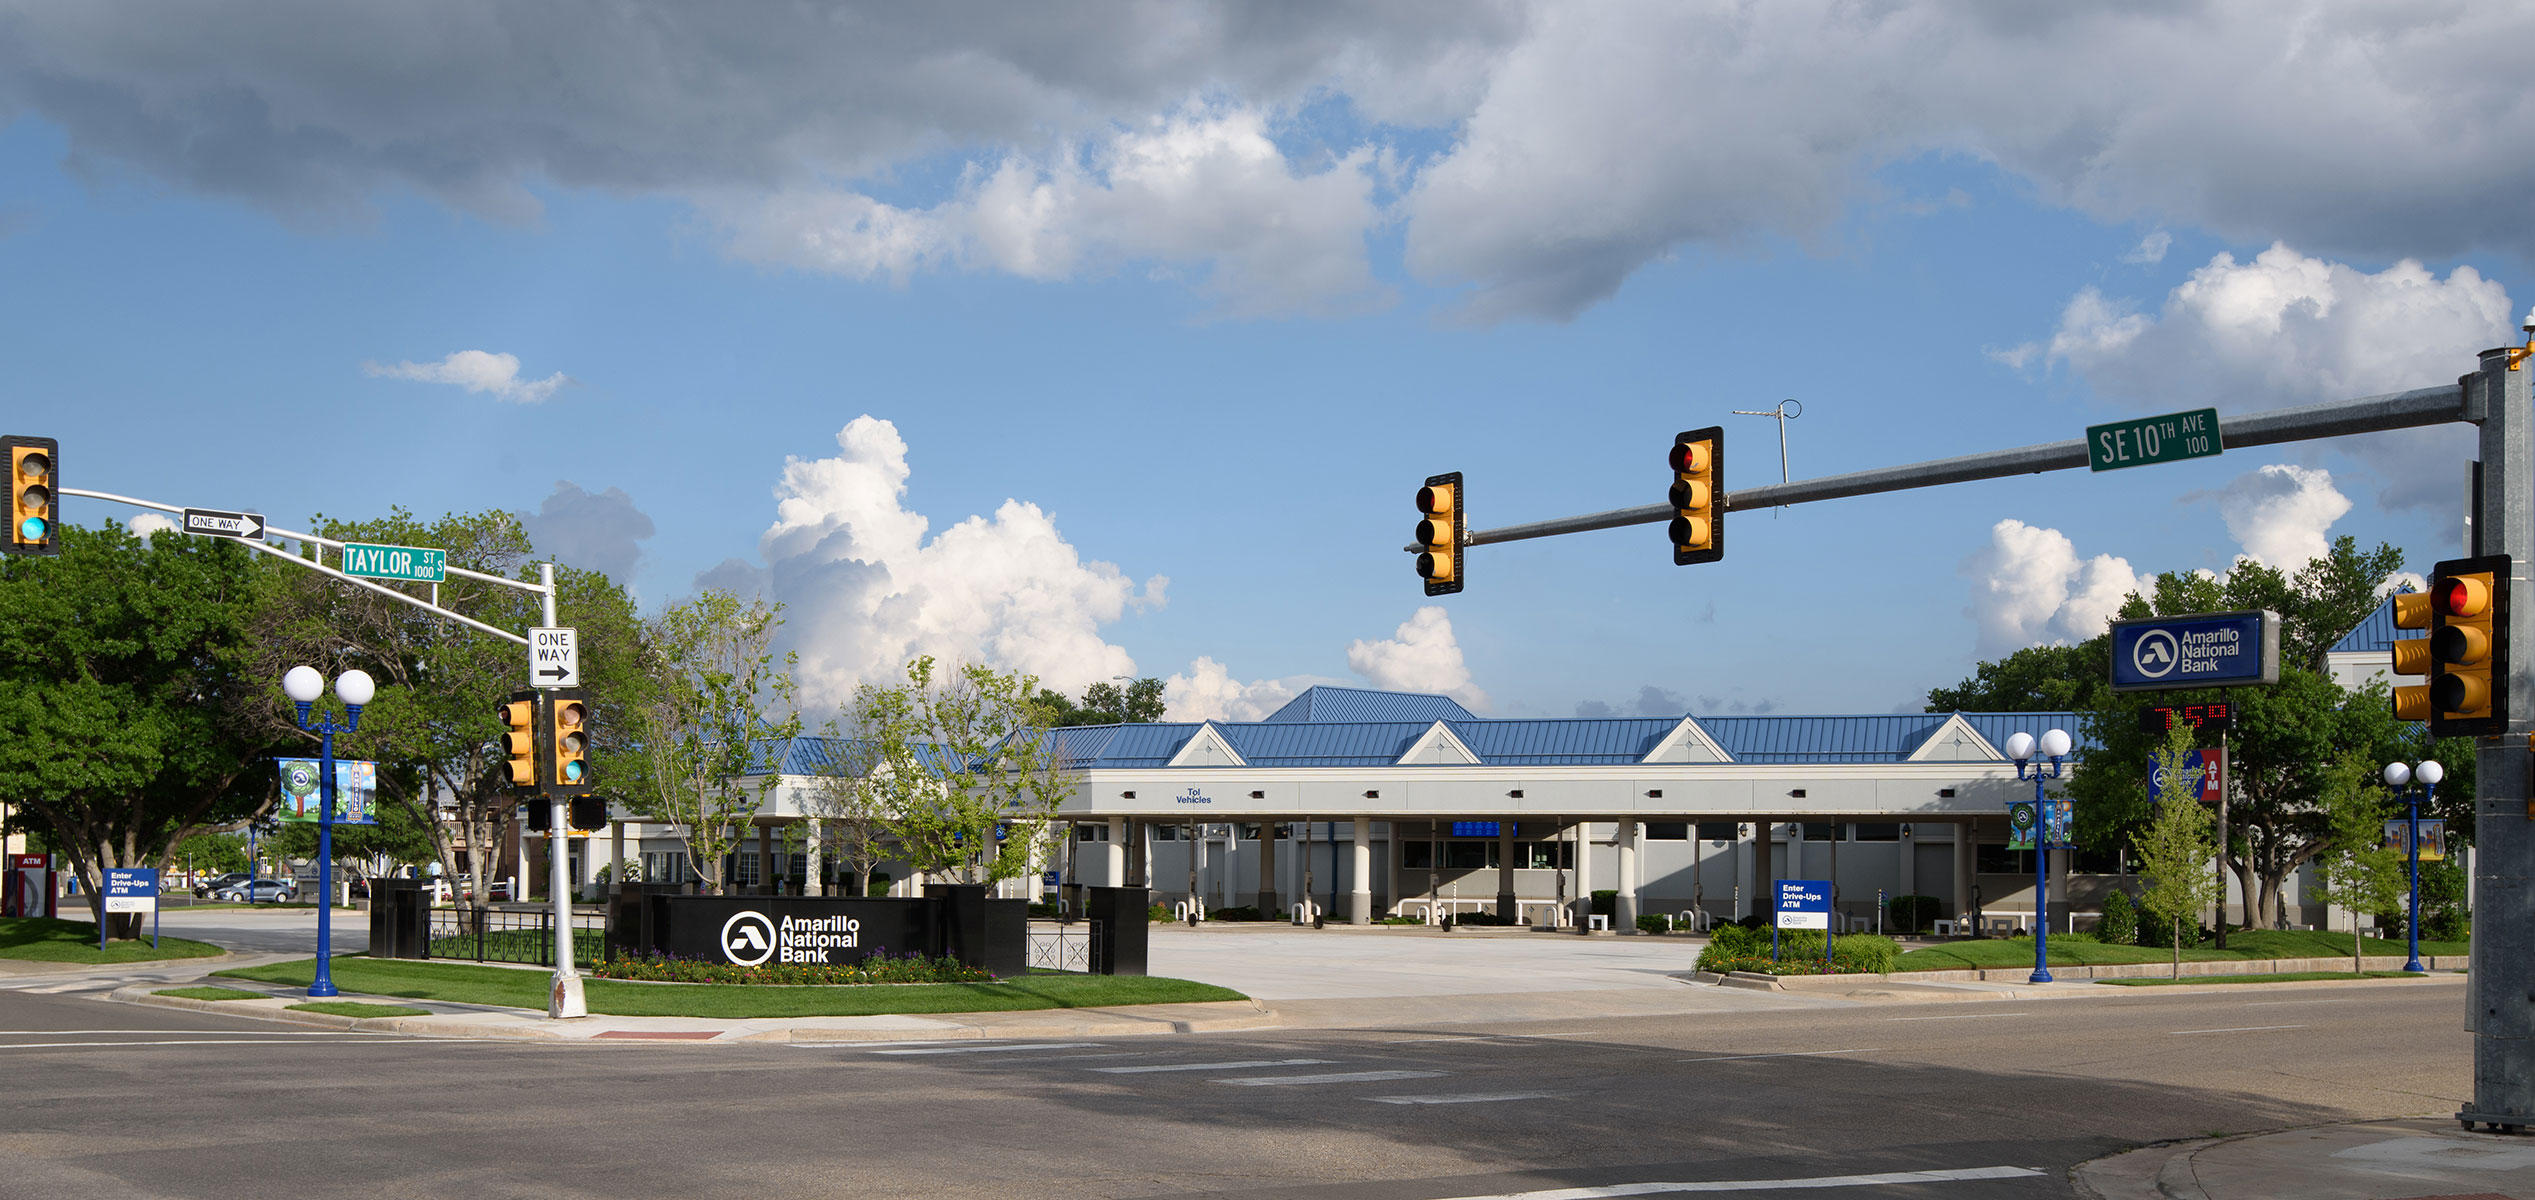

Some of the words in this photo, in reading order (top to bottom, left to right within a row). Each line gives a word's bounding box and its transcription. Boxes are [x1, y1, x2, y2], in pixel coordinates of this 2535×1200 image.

[2100, 429, 2130, 463] SE
[2133, 422, 2175, 458] 10TH
[2182, 414, 2206, 433] AVE
[2186, 435, 2209, 454] 100
[192, 516, 214, 529] ONE
[218, 519, 241, 530] WAY
[346, 548, 412, 575] TAYLOR
[423, 552, 435, 564] ST
[437, 560, 443, 572] S
[414, 566, 435, 579] 1000
[538, 633, 569, 646] ONE
[2181, 628, 2239, 645] Amarillo
[538, 648, 570, 661] WAY
[2181, 642, 2239, 659] National
[2181, 658, 2218, 673] Bank
[1176, 796, 1212, 804] Vehicles
[22, 857, 41, 865] ATM
[111, 872, 132, 880] Enter
[111, 879, 149, 888] Drive-Ups
[1782, 884, 1804, 892] Enter
[1782, 892, 1822, 901] Drive-Ups
[1782, 900, 1800, 908] ATM
[780, 915, 860, 932] Amarillo
[780, 931, 858, 948] National
[780, 946, 829, 963] Bank
